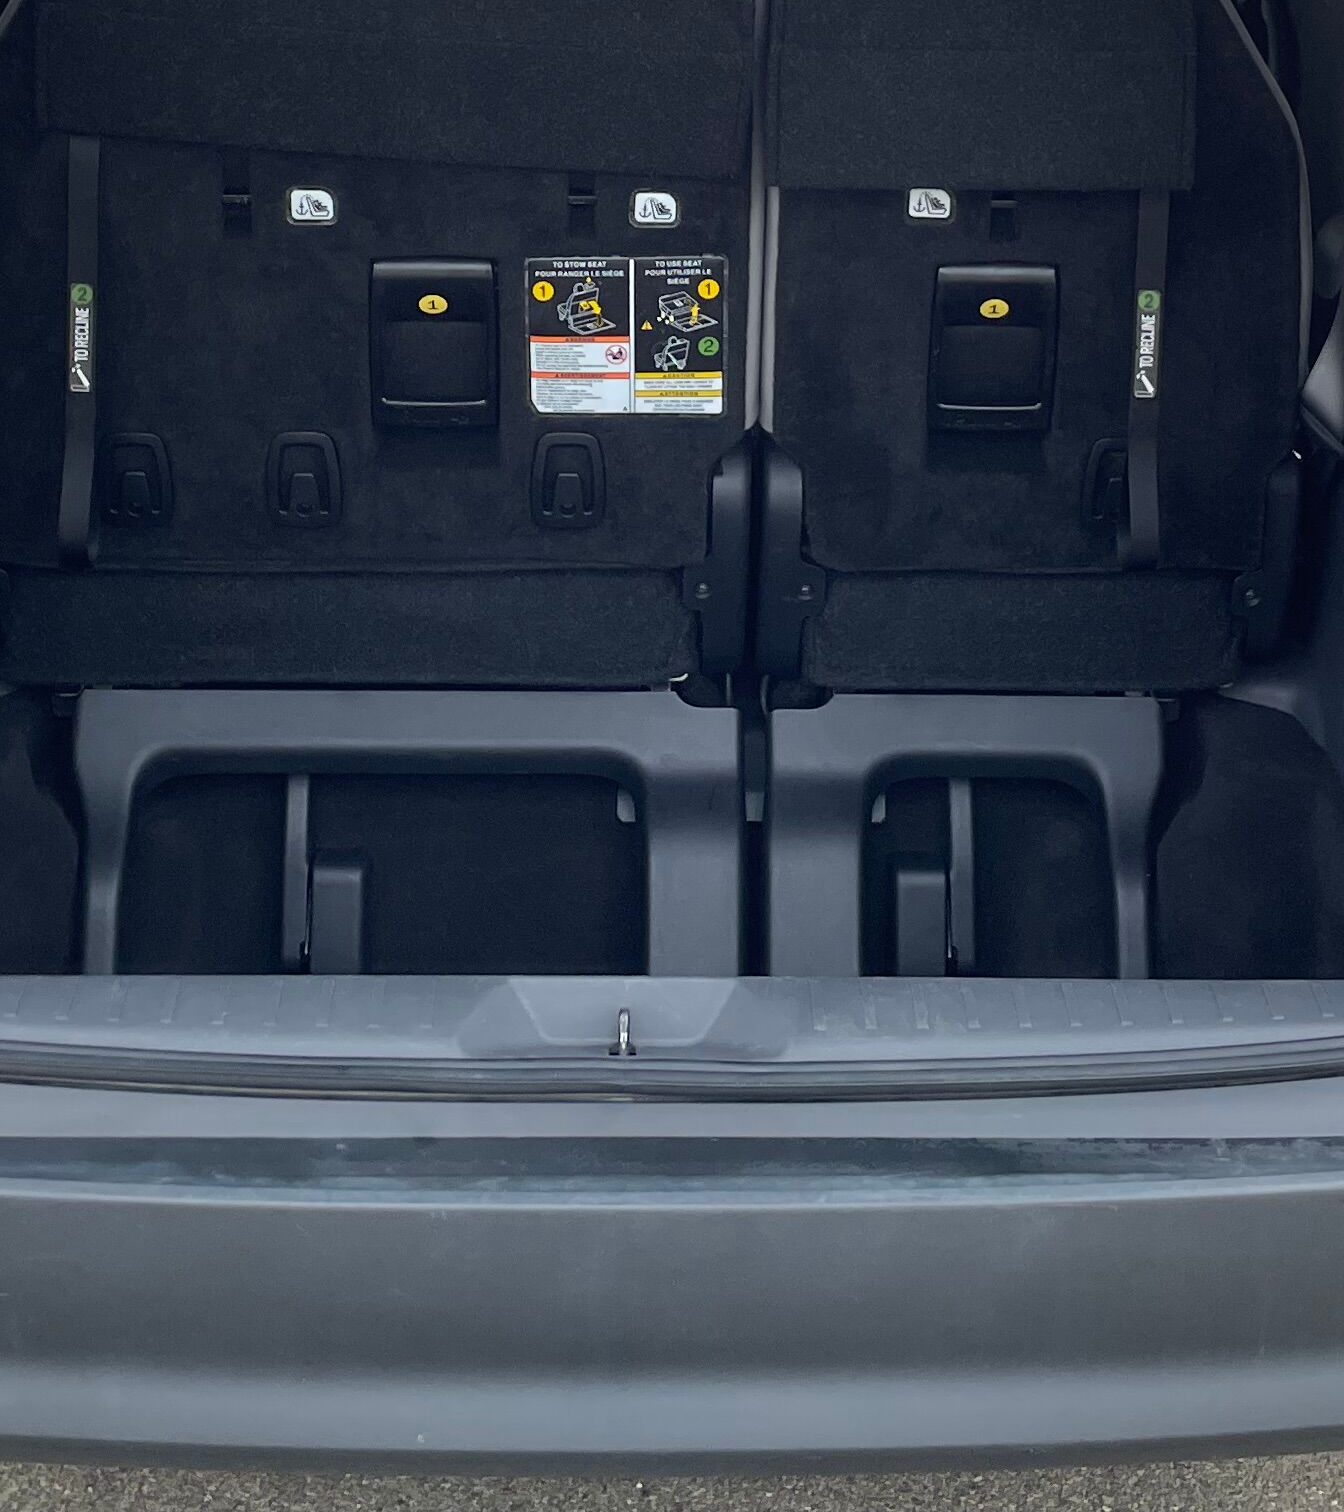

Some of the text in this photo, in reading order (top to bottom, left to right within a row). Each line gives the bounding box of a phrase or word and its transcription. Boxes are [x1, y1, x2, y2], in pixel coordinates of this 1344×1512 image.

[74, 307, 90, 362] TO RECLINE
[1139, 314, 1156, 368] TO RECLINE
